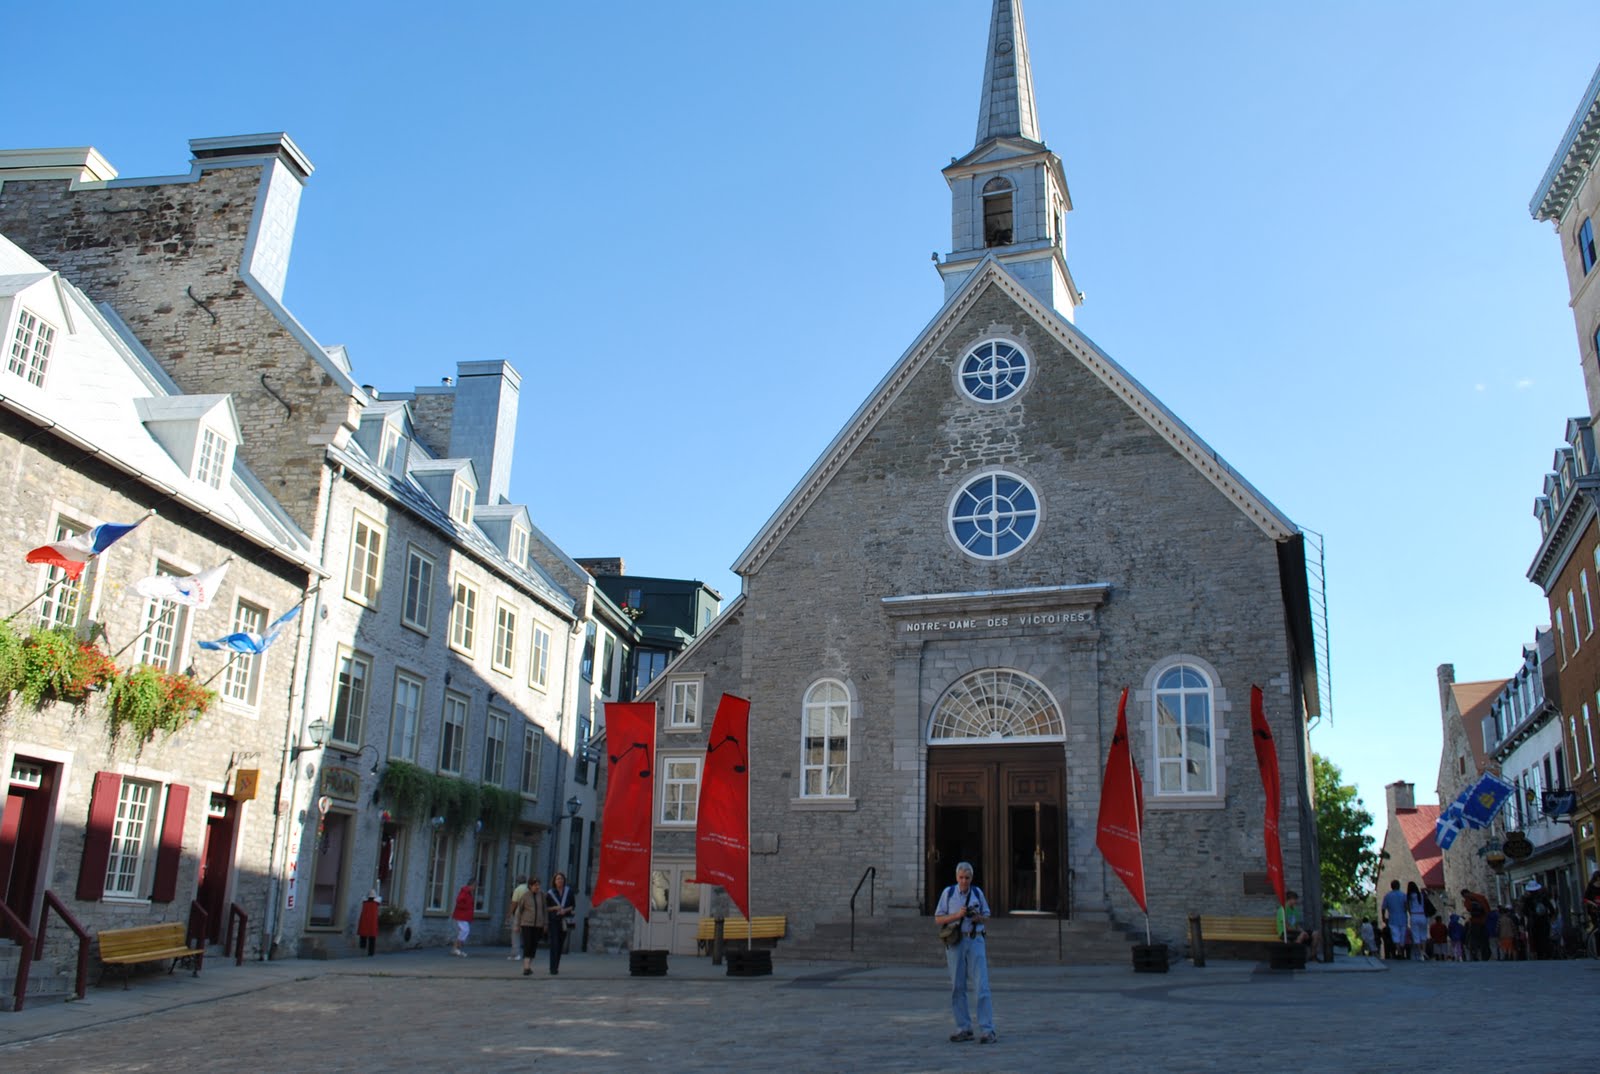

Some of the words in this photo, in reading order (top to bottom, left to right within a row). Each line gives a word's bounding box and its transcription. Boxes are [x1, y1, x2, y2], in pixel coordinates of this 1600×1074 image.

[907, 620, 976, 632] NOTRE-DAME
[987, 618, 1008, 627] DES
[1019, 613, 1085, 625] VICTOIRES
